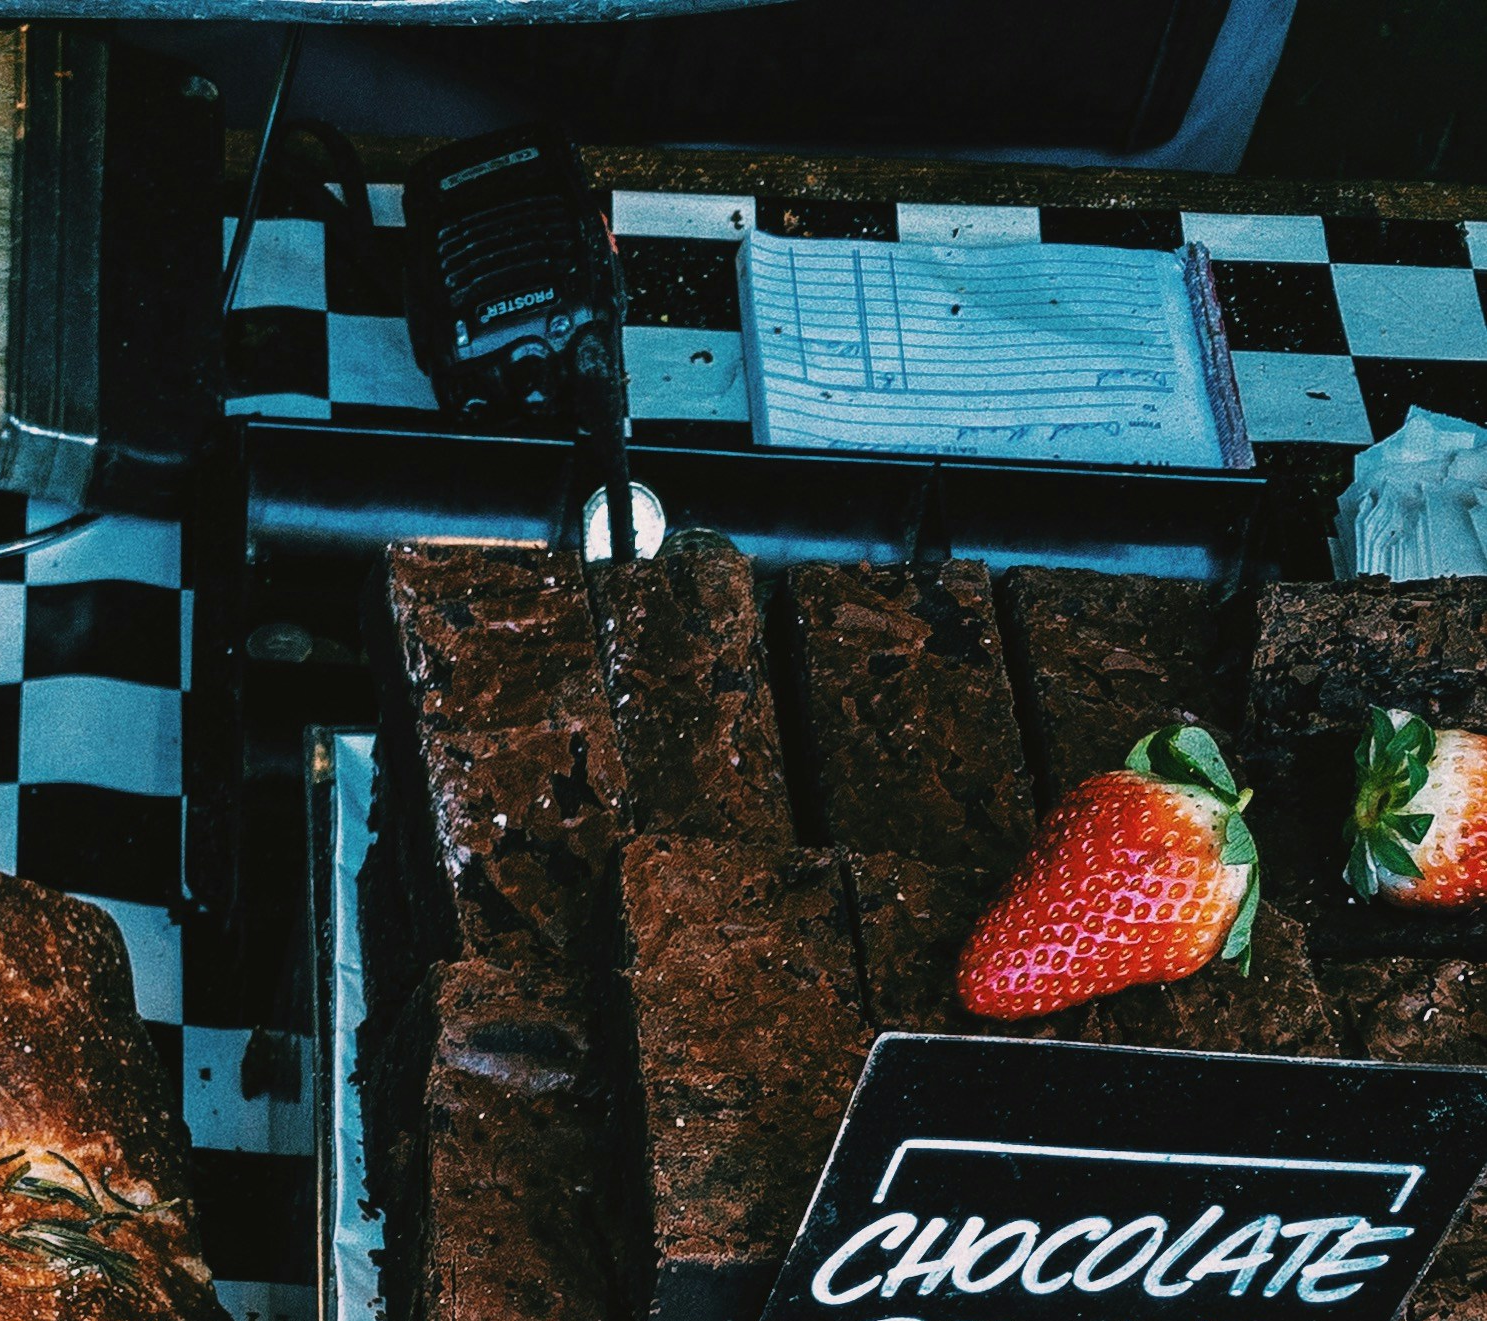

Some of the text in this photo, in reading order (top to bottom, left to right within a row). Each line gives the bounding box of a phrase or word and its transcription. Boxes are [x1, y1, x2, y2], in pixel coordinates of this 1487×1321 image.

[485, 287, 555, 317] PROSTER
[1142, 403, 1157, 413] To
[1128, 420, 1161, 430] From
[811, 1204, 1416, 1307] CHOCOLATE
